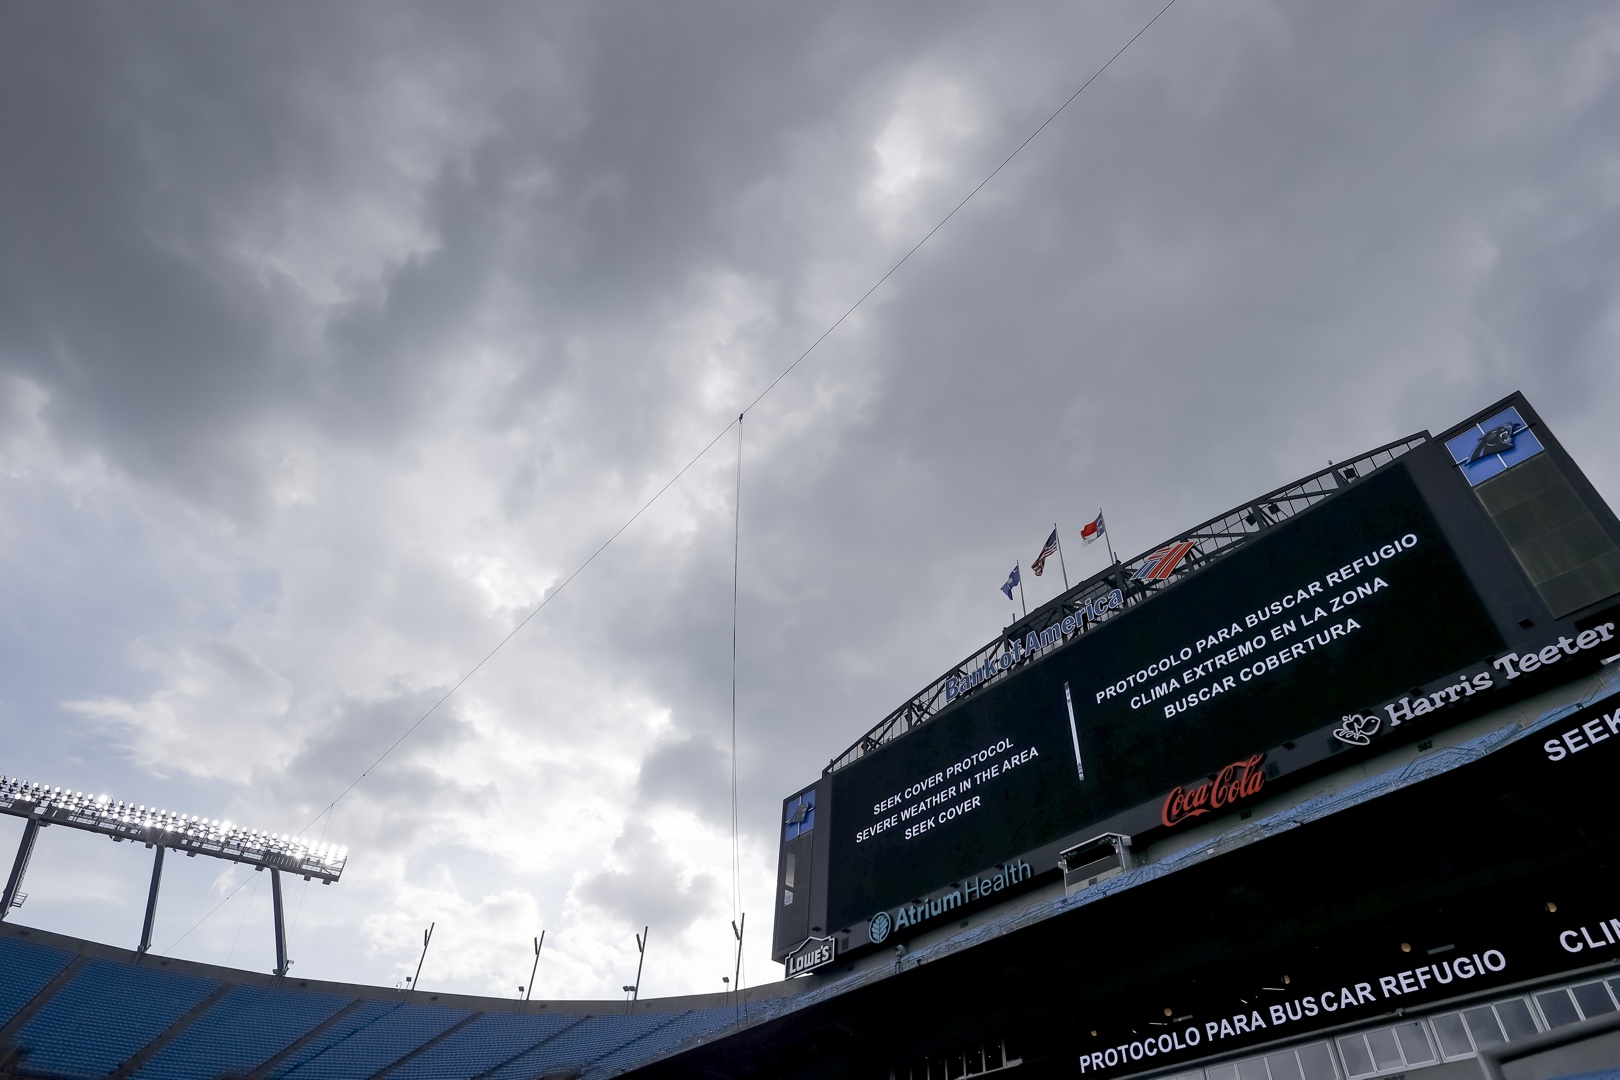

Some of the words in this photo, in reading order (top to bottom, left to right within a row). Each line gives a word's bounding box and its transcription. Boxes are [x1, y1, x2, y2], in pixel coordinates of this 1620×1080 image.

[945, 657, 999, 702] Bank
[1000, 638, 1022, 670] of
[1025, 588, 1125, 658] America
[1095, 647, 1193, 705] PROTOCOLO
[1195, 622, 1244, 654] PARA
[1245, 581, 1324, 628] BUSCAR
[1326, 533, 1418, 587] REFUGIO
[1130, 681, 1182, 710] CLIMA
[1183, 635, 1268, 684] EXTREMO
[1271, 619, 1297, 642] EN
[1301, 606, 1328, 628] LA
[1330, 576, 1389, 612] ZONA
[1164, 675, 1237, 719] BUSCAR
[1240, 617, 1362, 683] COBERTURA
[1384, 672, 1494, 727] Harris
[1494, 622, 1615, 680] Teeter
[873, 792, 902, 815] SEEK
[904, 772, 944, 799] COVER
[946, 738, 1014, 779] PROTOCOL
[1417, 740, 1433, 753] 503
[1543, 707, 1620, 762] SEEK
[856, 814, 898, 843] SEVERE
[900, 786, 957, 822] WEATHER
[959, 778, 972, 793] IN
[974, 764, 1000, 785] THE
[1002, 746, 1039, 773] AREA
[904, 817, 936, 840] SEEK
[938, 796, 982, 824] COVER
[1162, 752, 1264, 827] Coca-Cola
[894, 890, 962, 933] Atrium
[965, 859, 1032, 903] Health
[789, 944, 830, 975] LOWE'S
[1079, 1026, 1202, 1074] PROTOCOLO
[1205, 1010, 1267, 1042] PARA
[1269, 982, 1377, 1026] BUSCAR
[1379, 949, 1507, 998] REFUGIO
